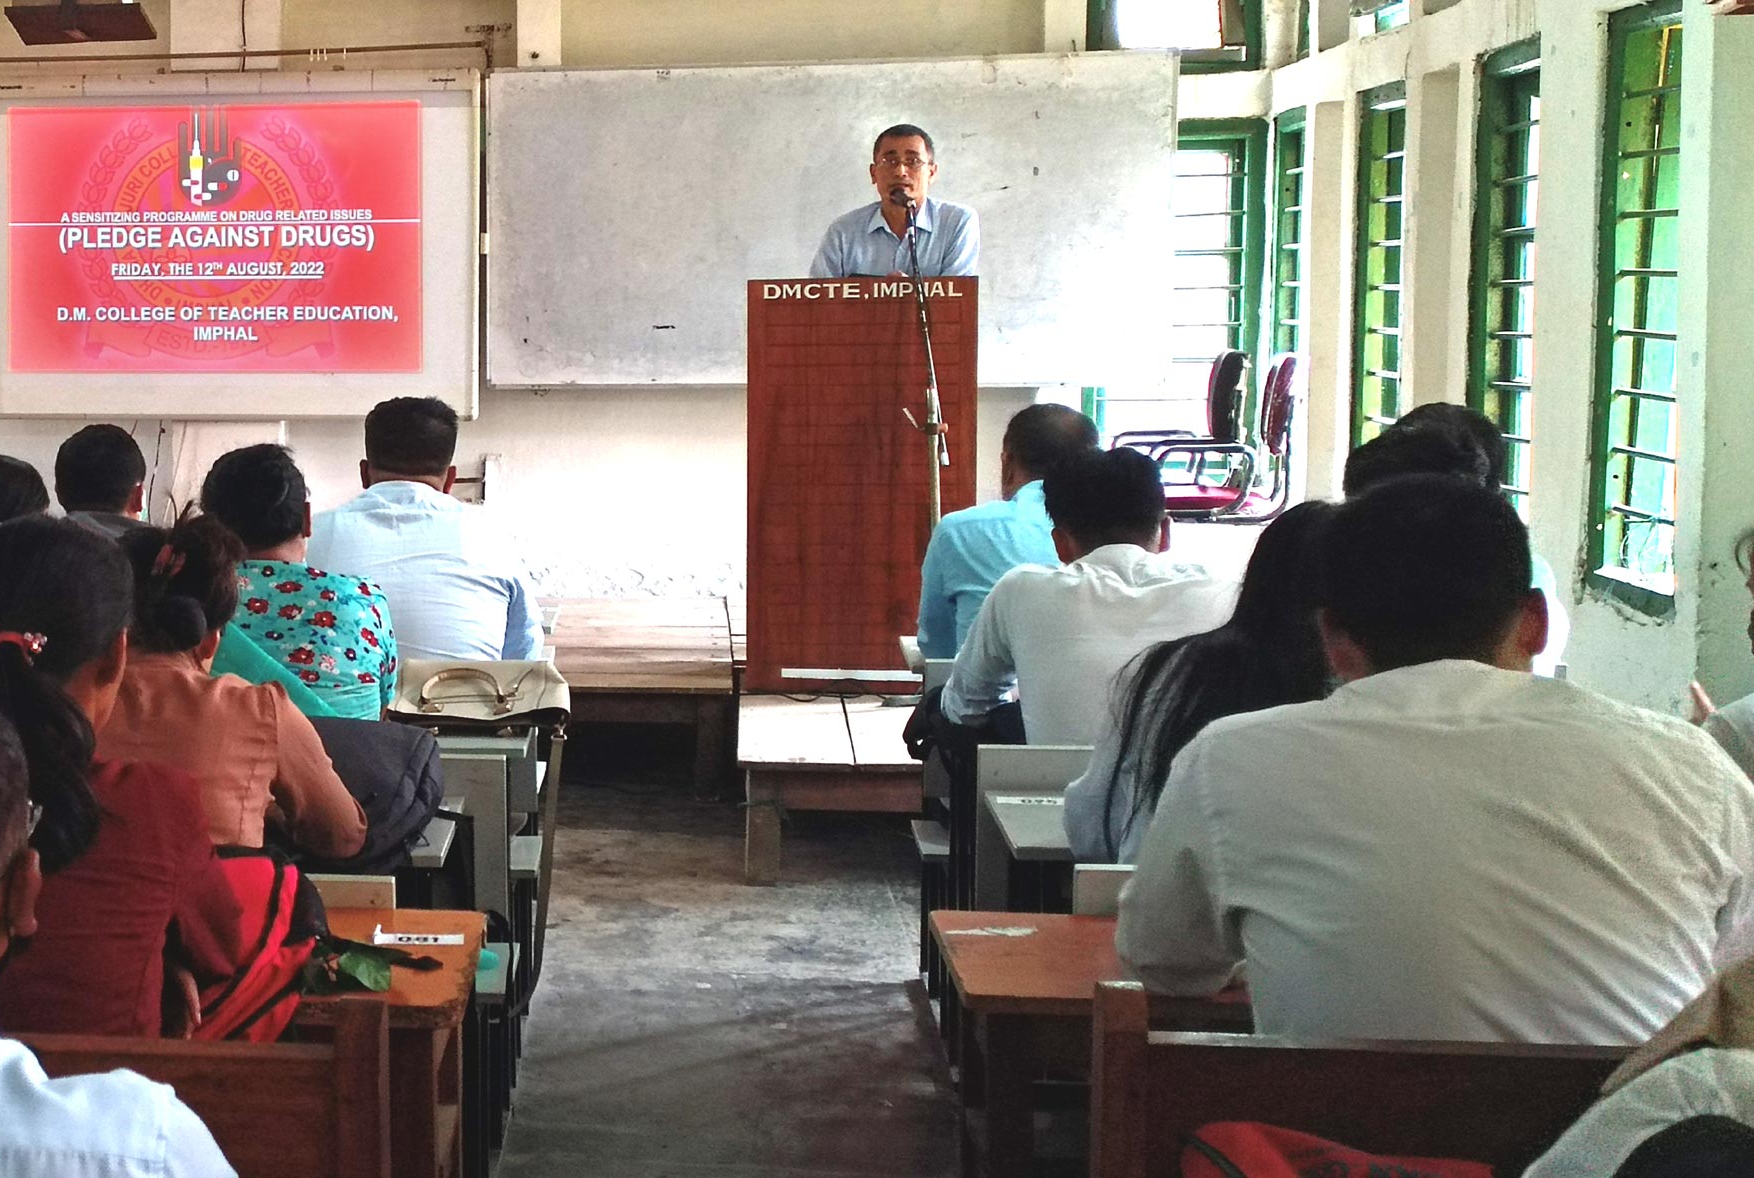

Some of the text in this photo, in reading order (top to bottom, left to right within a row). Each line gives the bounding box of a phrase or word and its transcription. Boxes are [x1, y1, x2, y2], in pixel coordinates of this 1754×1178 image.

[61, 209, 373, 223] A SENSITIZING PROGRAMME ON DRUG RELATED ISSUES
[59, 225, 375, 253] (PLEDGE AGAINST DRUGS)
[111, 262, 165, 277] FRIDAY,
[169, 262, 193, 276] THE
[226, 262, 286, 277] AUGUST,
[290, 261, 325, 275] 2022
[57, 306, 91, 321] D.M.
[96, 306, 175, 321] COLLEGE
[180, 306, 203, 321] OF
[208, 306, 289, 321] TEACHER
[293, 305, 398, 322] EDUCATION,
[193, 326, 258, 341] IMPHAL
